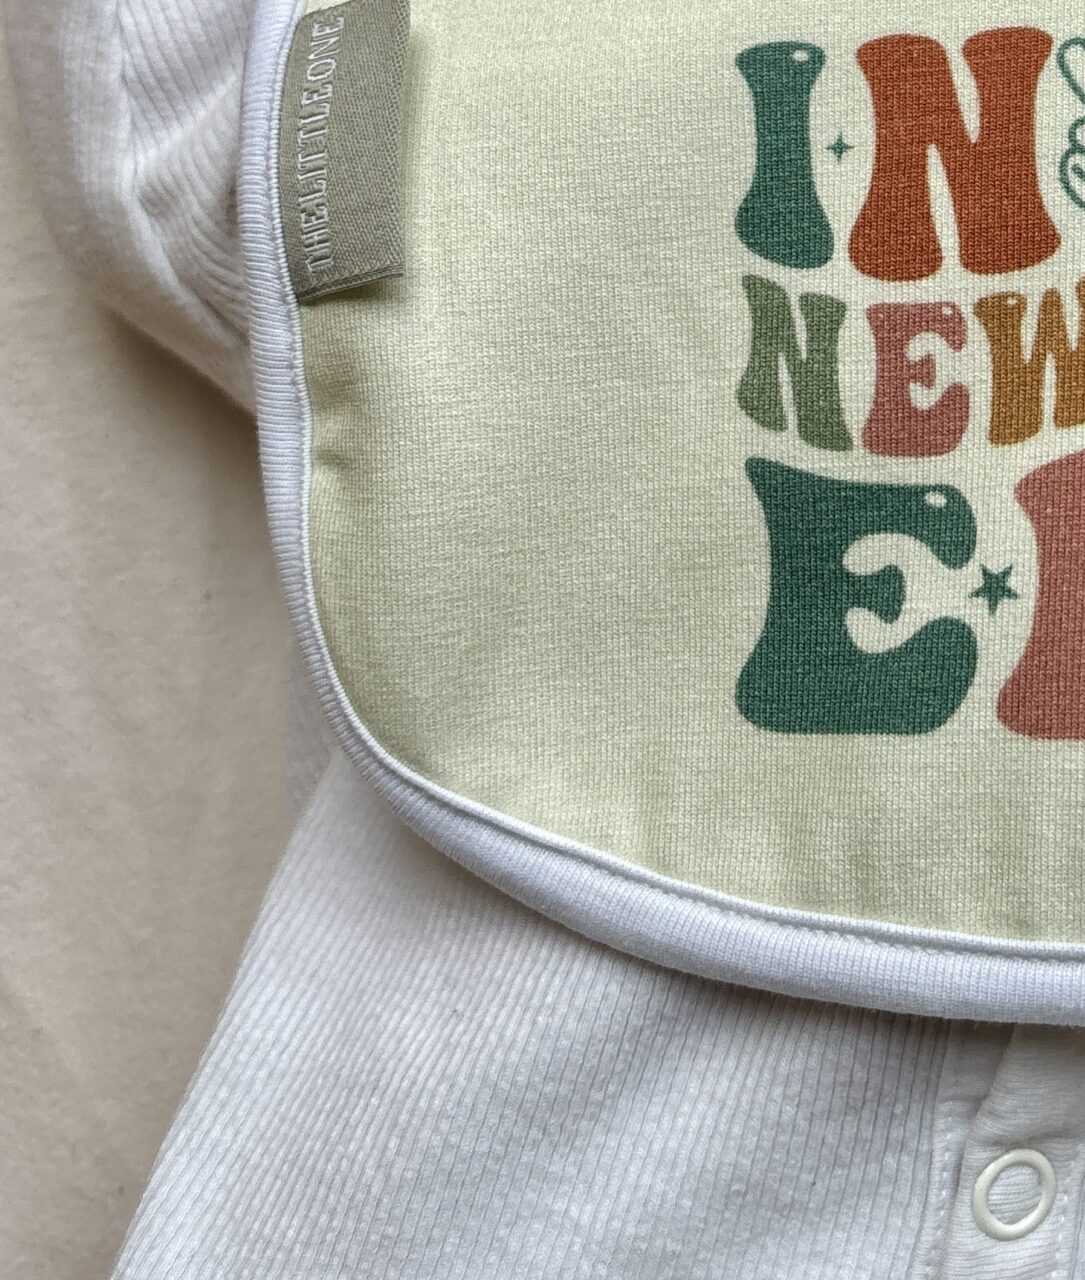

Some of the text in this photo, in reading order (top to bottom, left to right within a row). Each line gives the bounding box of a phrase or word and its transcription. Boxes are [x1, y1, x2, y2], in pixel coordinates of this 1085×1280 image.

[297, 16, 345, 272] THE LITTLE ONE
[733, 25, 1062, 283] IN
